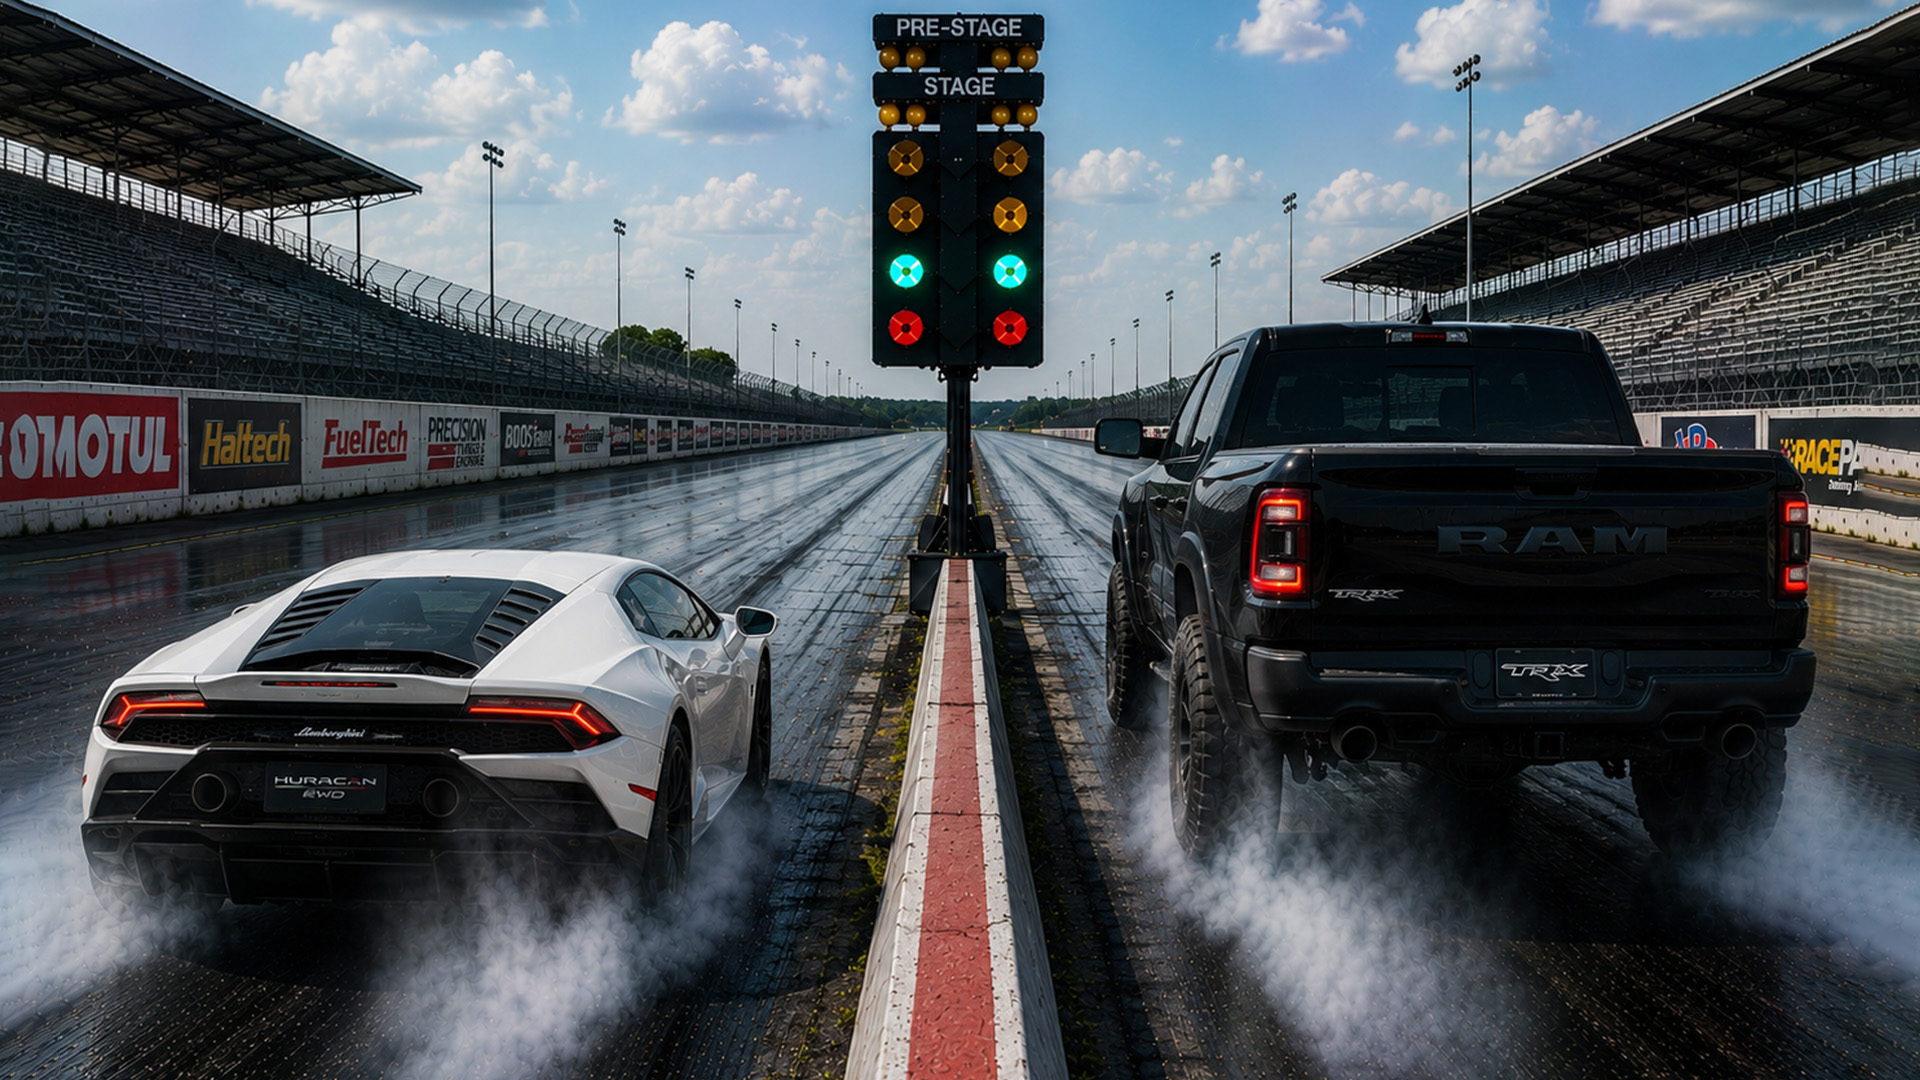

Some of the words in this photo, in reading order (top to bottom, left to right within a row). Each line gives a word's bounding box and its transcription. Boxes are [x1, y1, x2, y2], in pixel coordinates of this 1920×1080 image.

[896, 18, 1022, 37] PRE-STAGE
[924, 77, 995, 95] STAGE
[323, 419, 408, 456] FuelTech
[427, 417, 487, 443] PRECISION
[201, 420, 290, 467] Haltech
[1437, 525, 1668, 554] RAM
[1501, 663, 1589, 682] TRX
